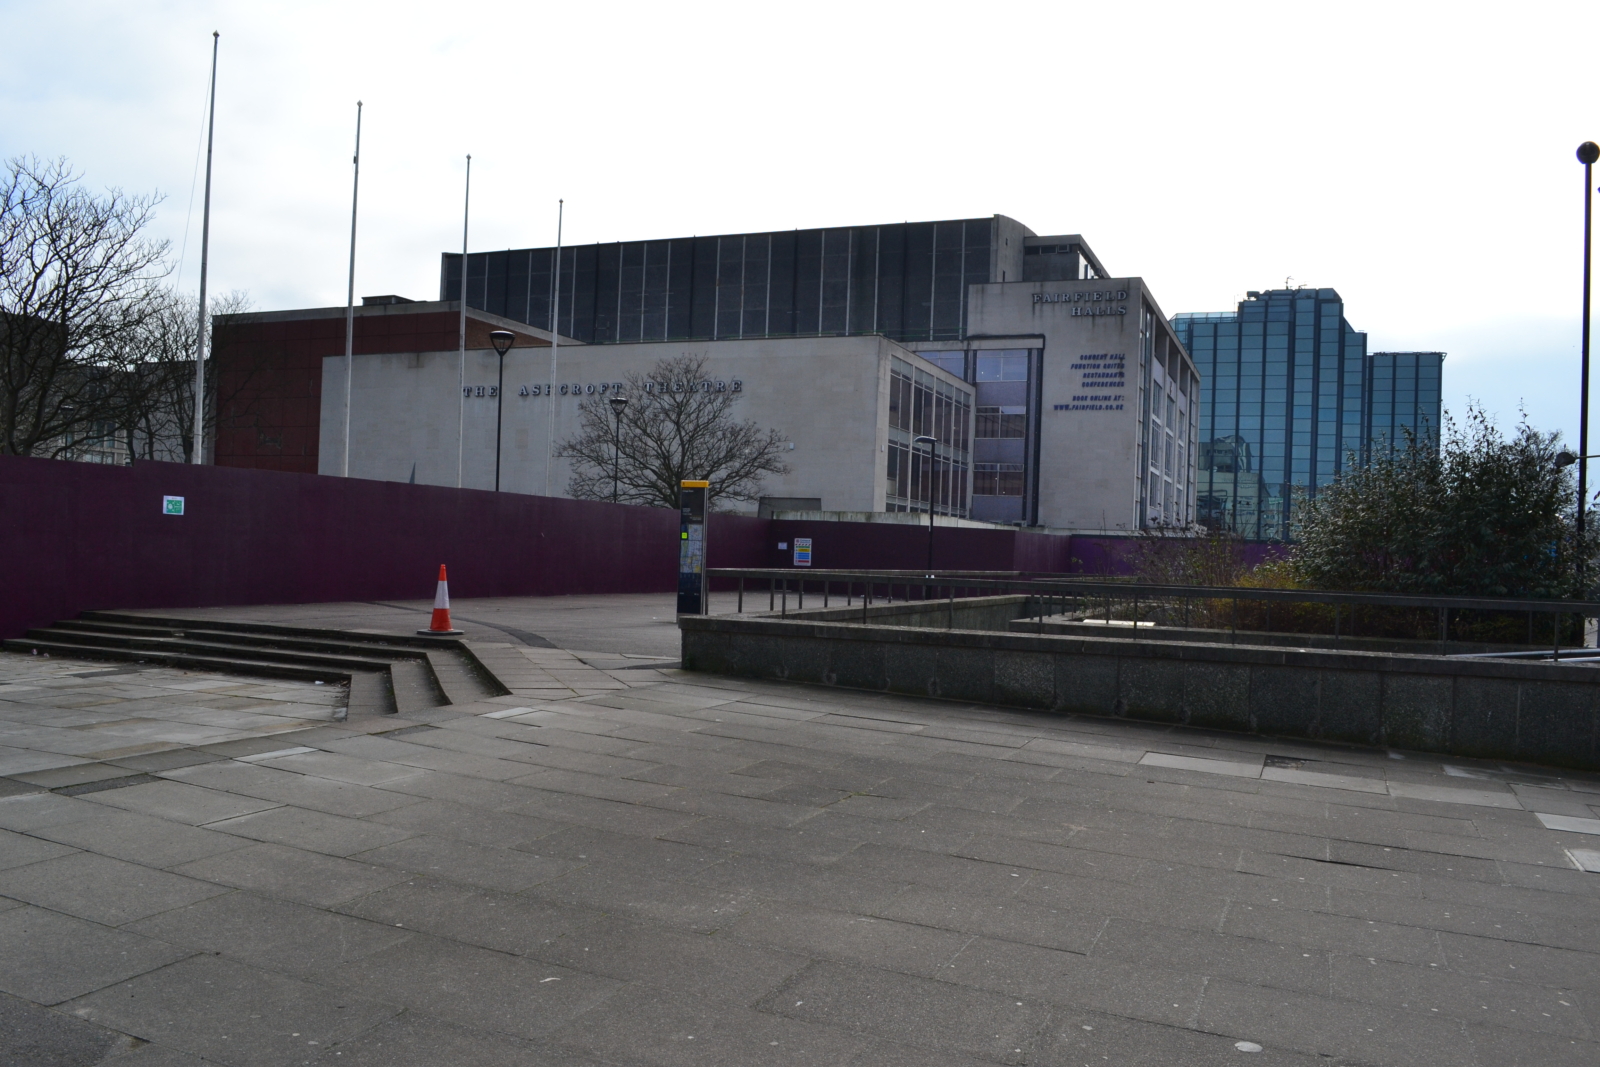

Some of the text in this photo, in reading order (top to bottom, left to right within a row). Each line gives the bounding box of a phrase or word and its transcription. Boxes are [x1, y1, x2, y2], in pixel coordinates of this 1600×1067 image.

[1032, 290, 1128, 303] FAIRFIELD
[1071, 305, 1127, 317] HALLS
[463, 385, 498, 397] THE
